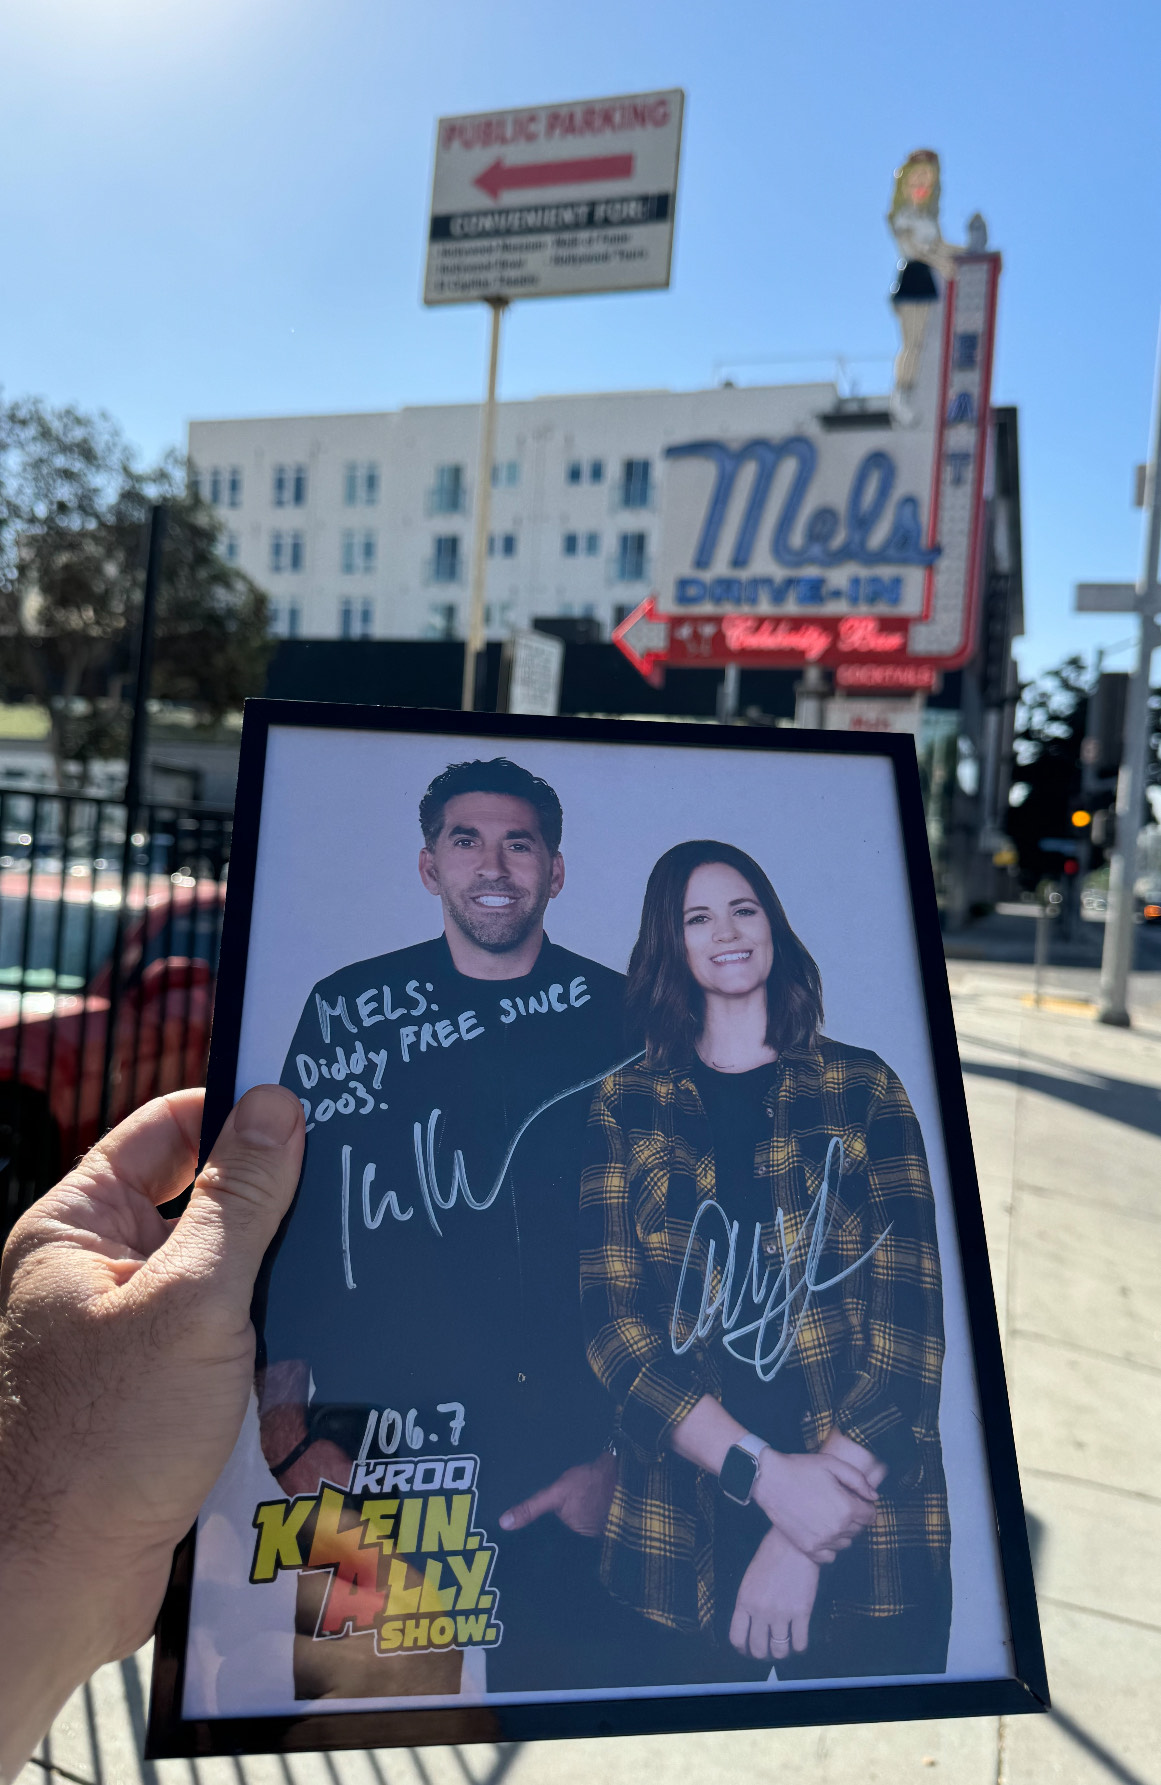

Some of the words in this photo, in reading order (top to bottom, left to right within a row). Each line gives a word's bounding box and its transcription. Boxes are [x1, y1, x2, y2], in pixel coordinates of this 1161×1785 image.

[441, 112, 540, 150] PUBLIC
[545, 98, 672, 138] PARKING
[449, 201, 589, 236] CONVENIENT
[665, 435, 943, 569] Mels
[675, 574, 902, 606] DRIVE-IN
[296, 1041, 388, 1089] Diddy
[400, 1010, 485, 1062] FREE
[500, 976, 591, 1024] SINCE
[315, 979, 438, 1043] MELS:
[357, 1401, 465, 1465] 106.7
[352, 1459, 475, 1495] KROQ
[379, 1614, 498, 1649] SHOW.
